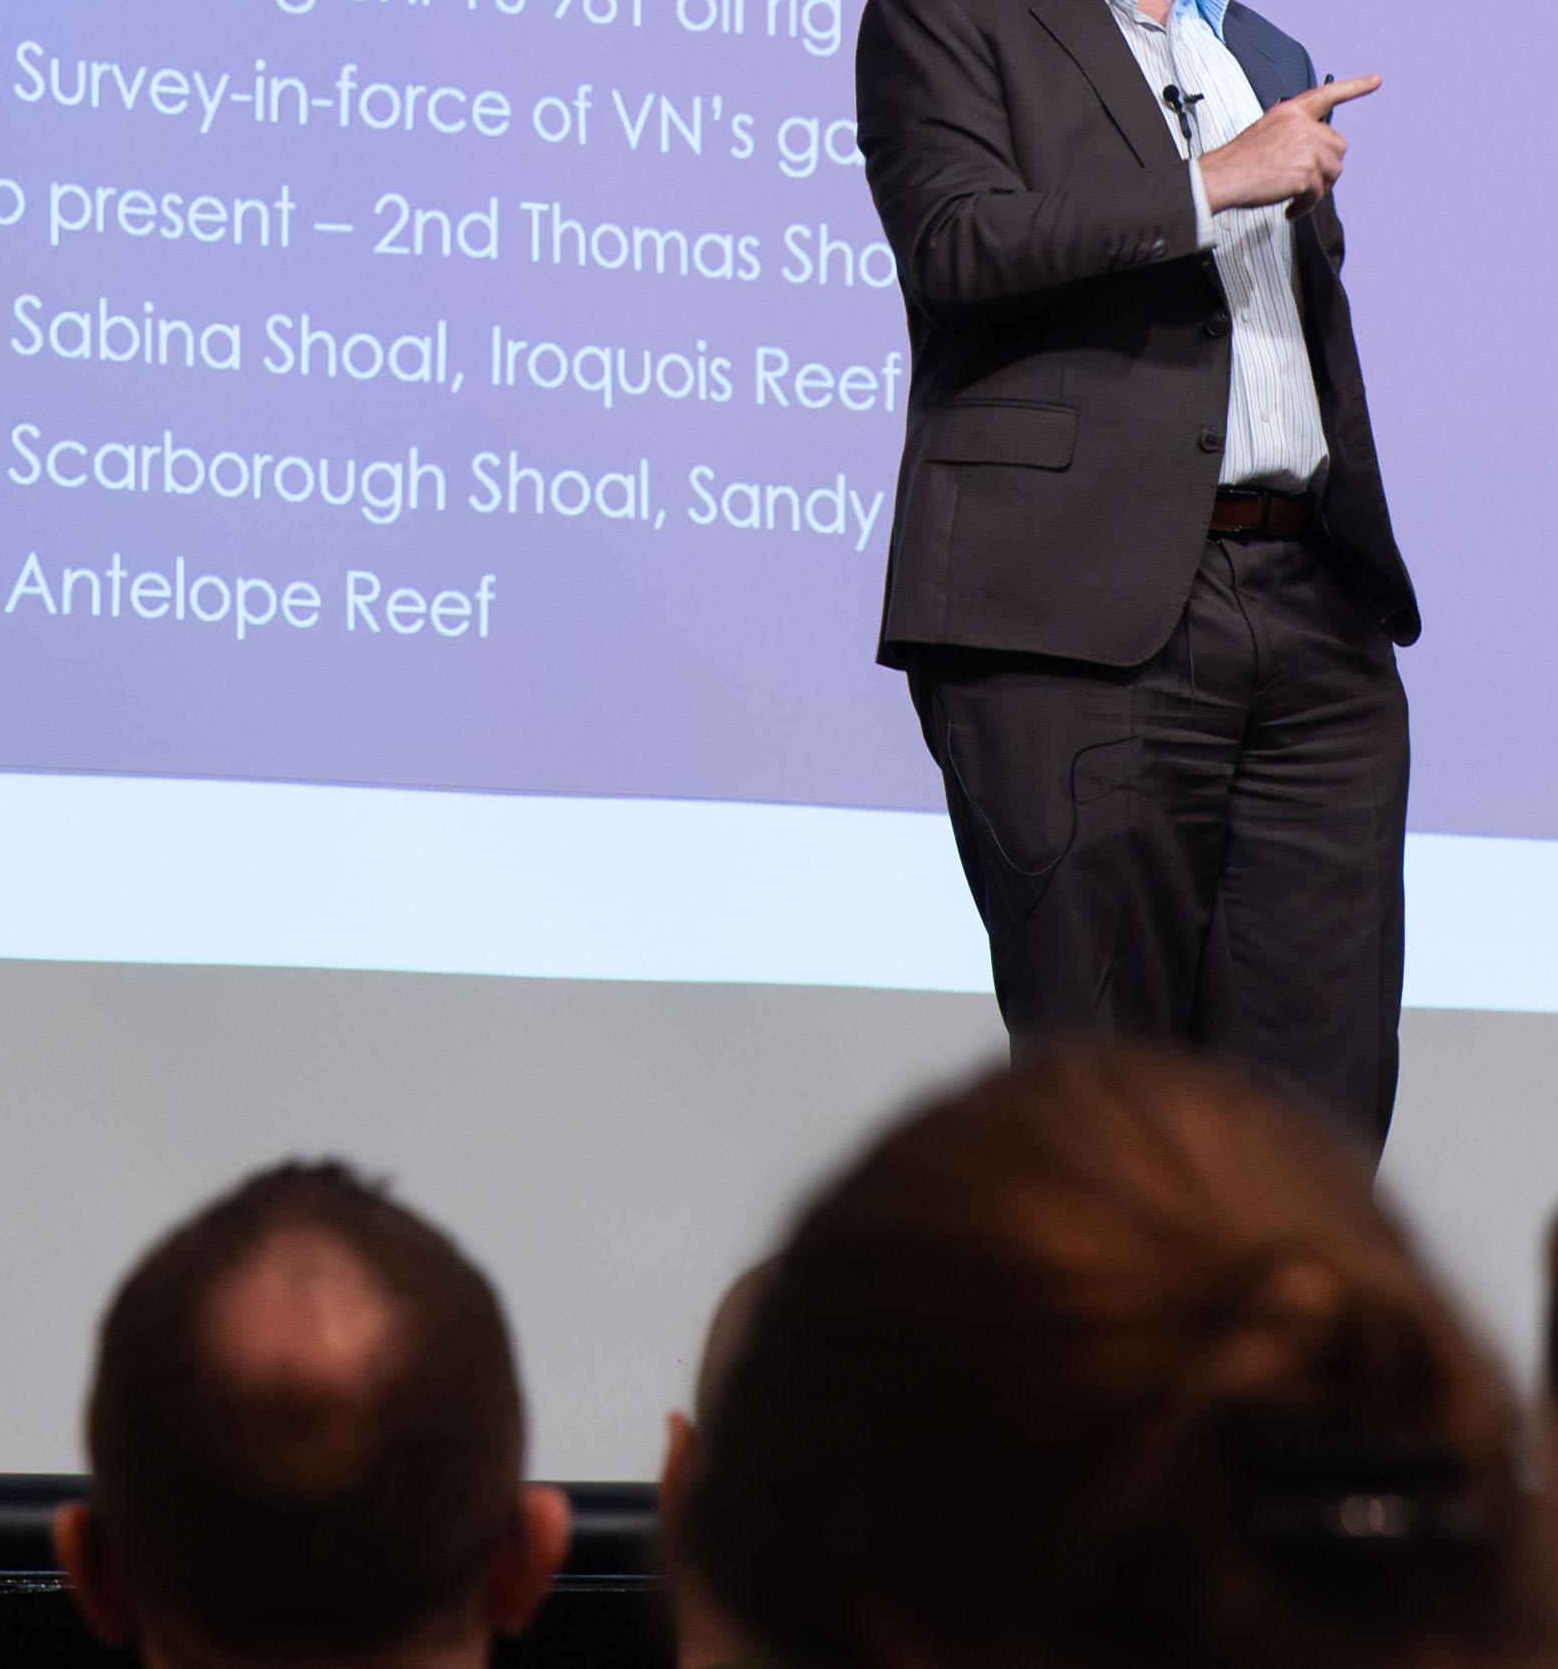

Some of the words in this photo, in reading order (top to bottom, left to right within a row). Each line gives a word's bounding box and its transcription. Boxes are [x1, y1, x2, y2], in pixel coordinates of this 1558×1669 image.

[13, 40, 512, 137] Survey-in-force
[532, 83, 593, 146] of
[777, 116, 866, 179] ga
[49, 181, 296, 250] present
[373, 192, 499, 261] 2nd
[519, 201, 762, 282] Thomas
[781, 223, 898, 288] Sho
[10, 293, 241, 371] Sabina
[262, 313, 465, 394] Shoal,
[491, 325, 733, 410] Iroquois
[755, 346, 903, 413] Reef
[7, 422, 447, 525] Scarborough
[468, 449, 667, 531] Shoal,
[687, 464, 885, 552] Sandy
[3, 551, 322, 641] Antelope
[346, 569, 497, 639] Reef
